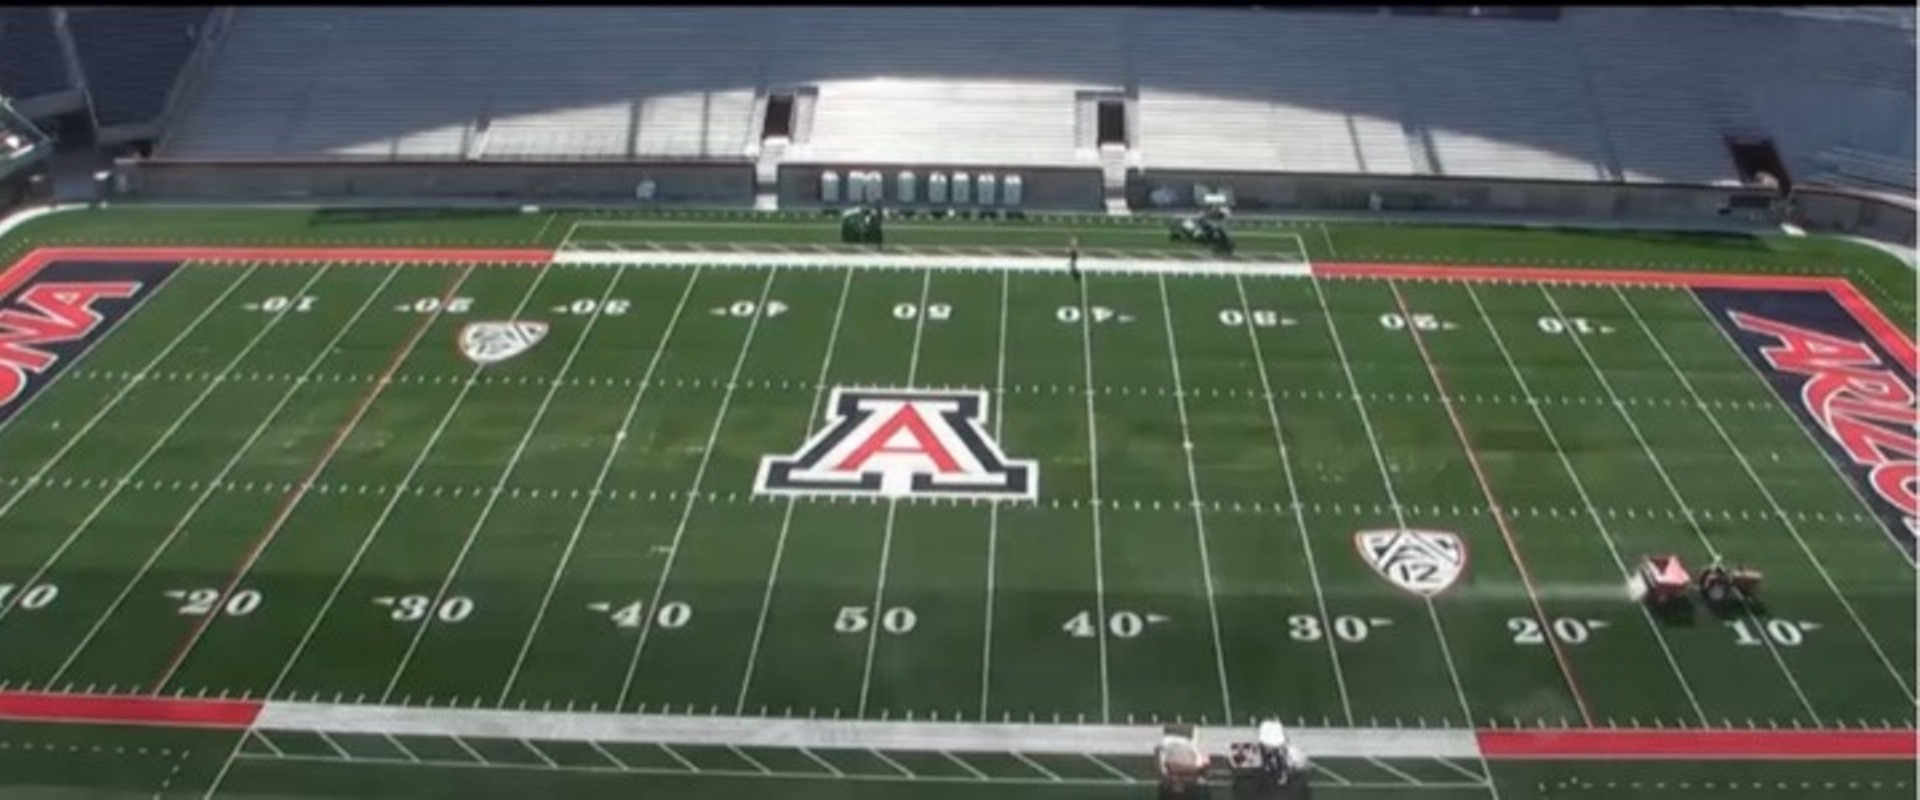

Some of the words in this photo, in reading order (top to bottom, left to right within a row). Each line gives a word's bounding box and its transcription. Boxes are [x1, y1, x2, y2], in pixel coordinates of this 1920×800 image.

[892, 303, 952, 319] 50
[1056, 305, 1113, 322] 40
[0, 281, 143, 407] NA
[753, 387, 1038, 501] A
[1400, 564, 1442, 583] 12
[179, 588, 262, 615] 20
[391, 595, 474, 622] 30
[611, 601, 692, 627] 40
[834, 606, 917, 633] 50
[1062, 611, 1142, 637] 40
[1288, 615, 1368, 642] 30
[1508, 617, 1588, 643] 20
[1723, 619, 1803, 645] 10
